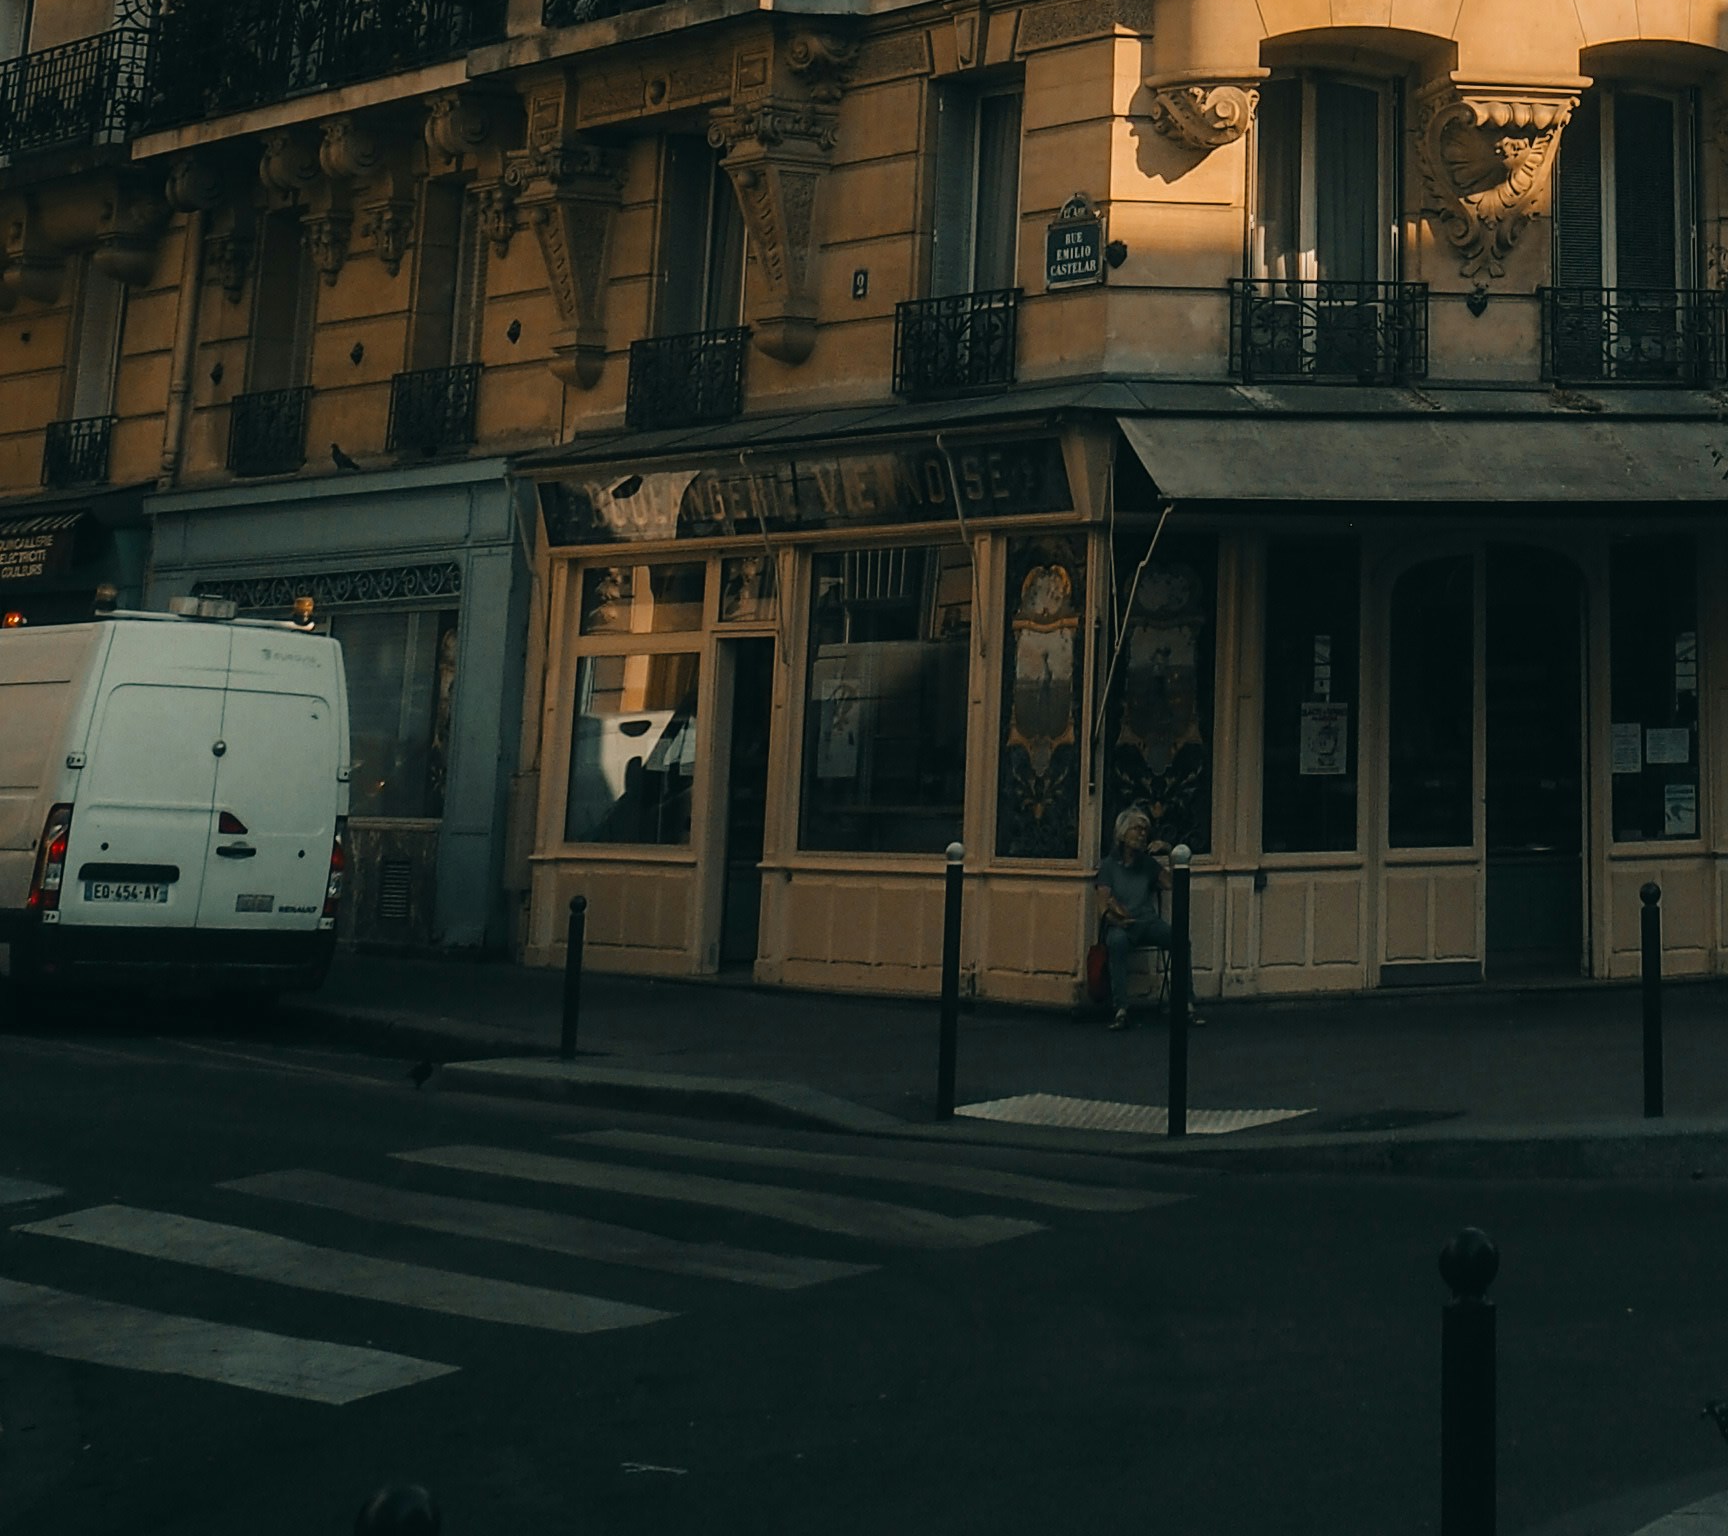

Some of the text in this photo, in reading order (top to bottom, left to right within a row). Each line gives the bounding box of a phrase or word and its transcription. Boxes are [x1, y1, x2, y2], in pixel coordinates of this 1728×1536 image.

[1065, 232, 1083, 245] RUE
[1056, 246, 1092, 261] EMILIO
[1050, 259, 1097, 277] CASTELAR
